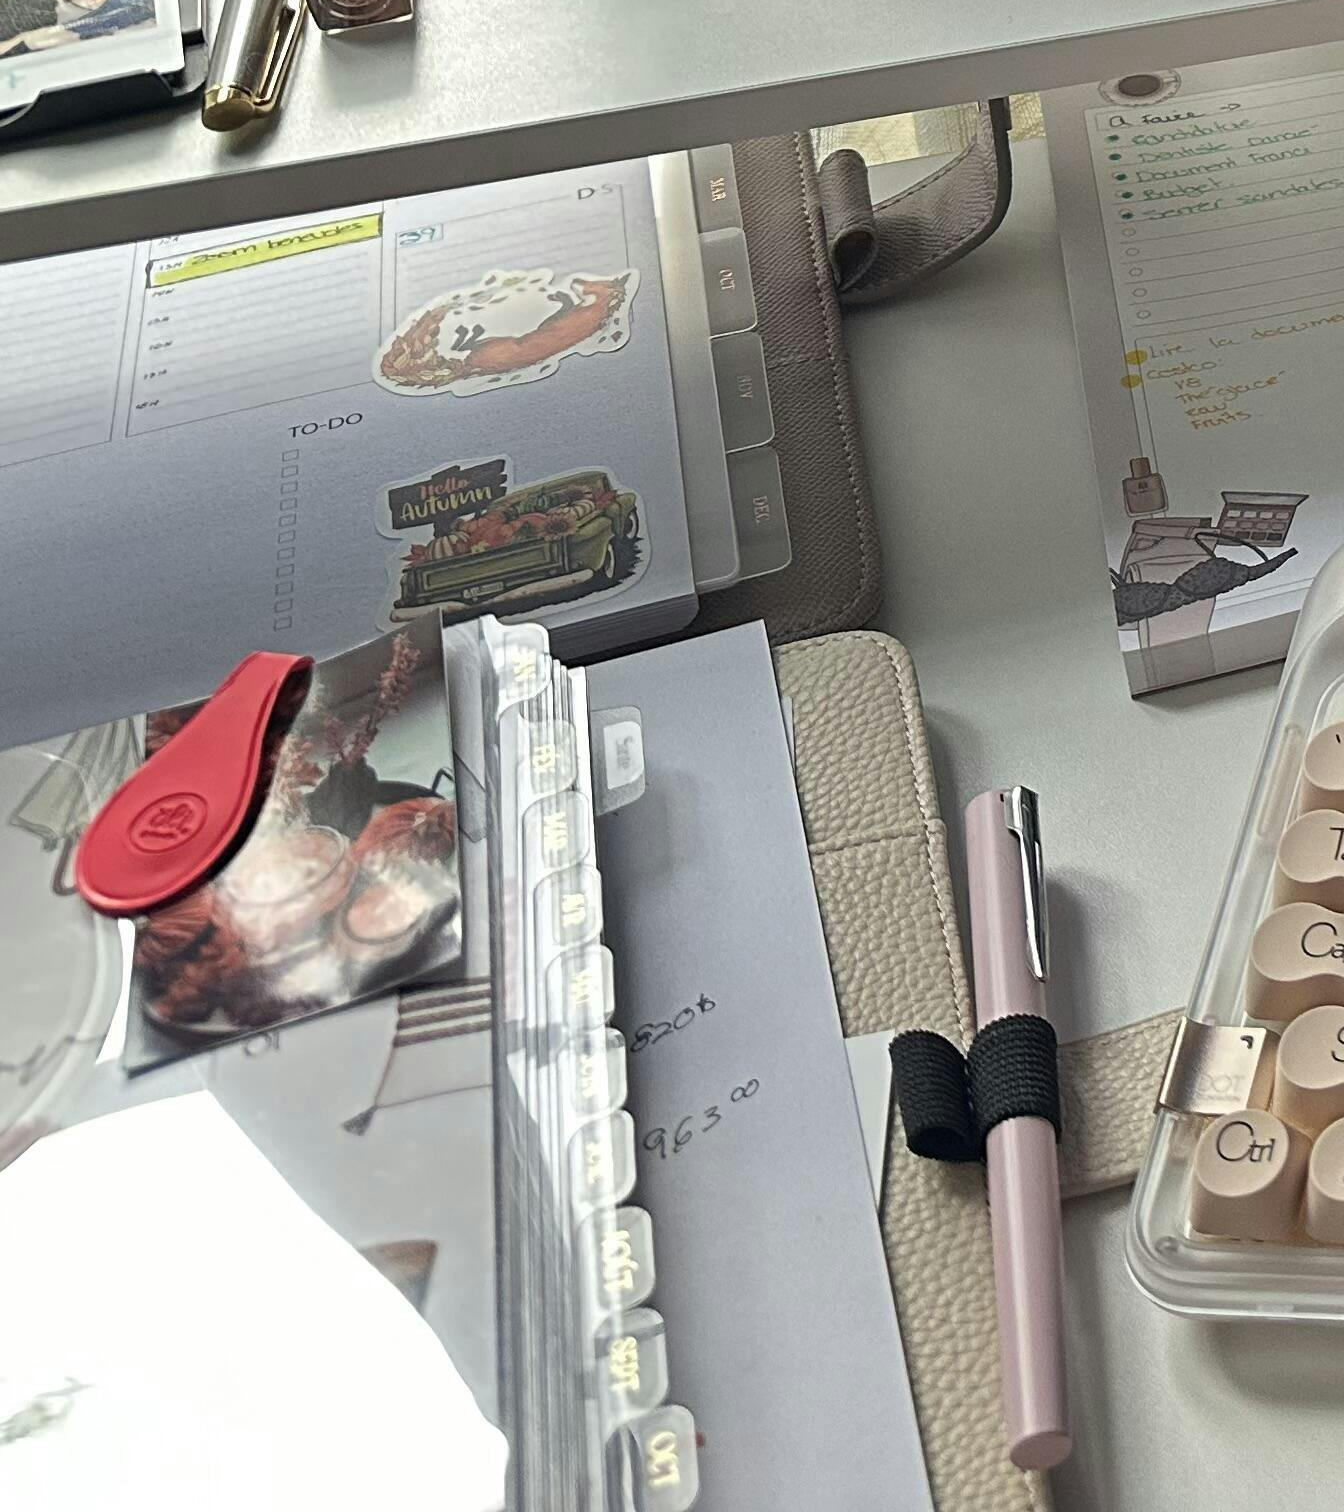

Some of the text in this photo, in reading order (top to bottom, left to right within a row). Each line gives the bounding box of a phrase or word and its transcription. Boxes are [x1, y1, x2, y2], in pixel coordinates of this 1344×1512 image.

[1148, 342, 1196, 360] Lire
[1208, 336, 1238, 349] la
[288, 412, 364, 438] TO-DO
[1184, 401, 1228, 417] eau
[399, 484, 493, 522] Autumn
[419, 475, 471, 501] Hello
[642, 1105, 722, 1159] 963
[1214, 1119, 1277, 1165] Ctrl
[647, 1430, 681, 1487] OCT
